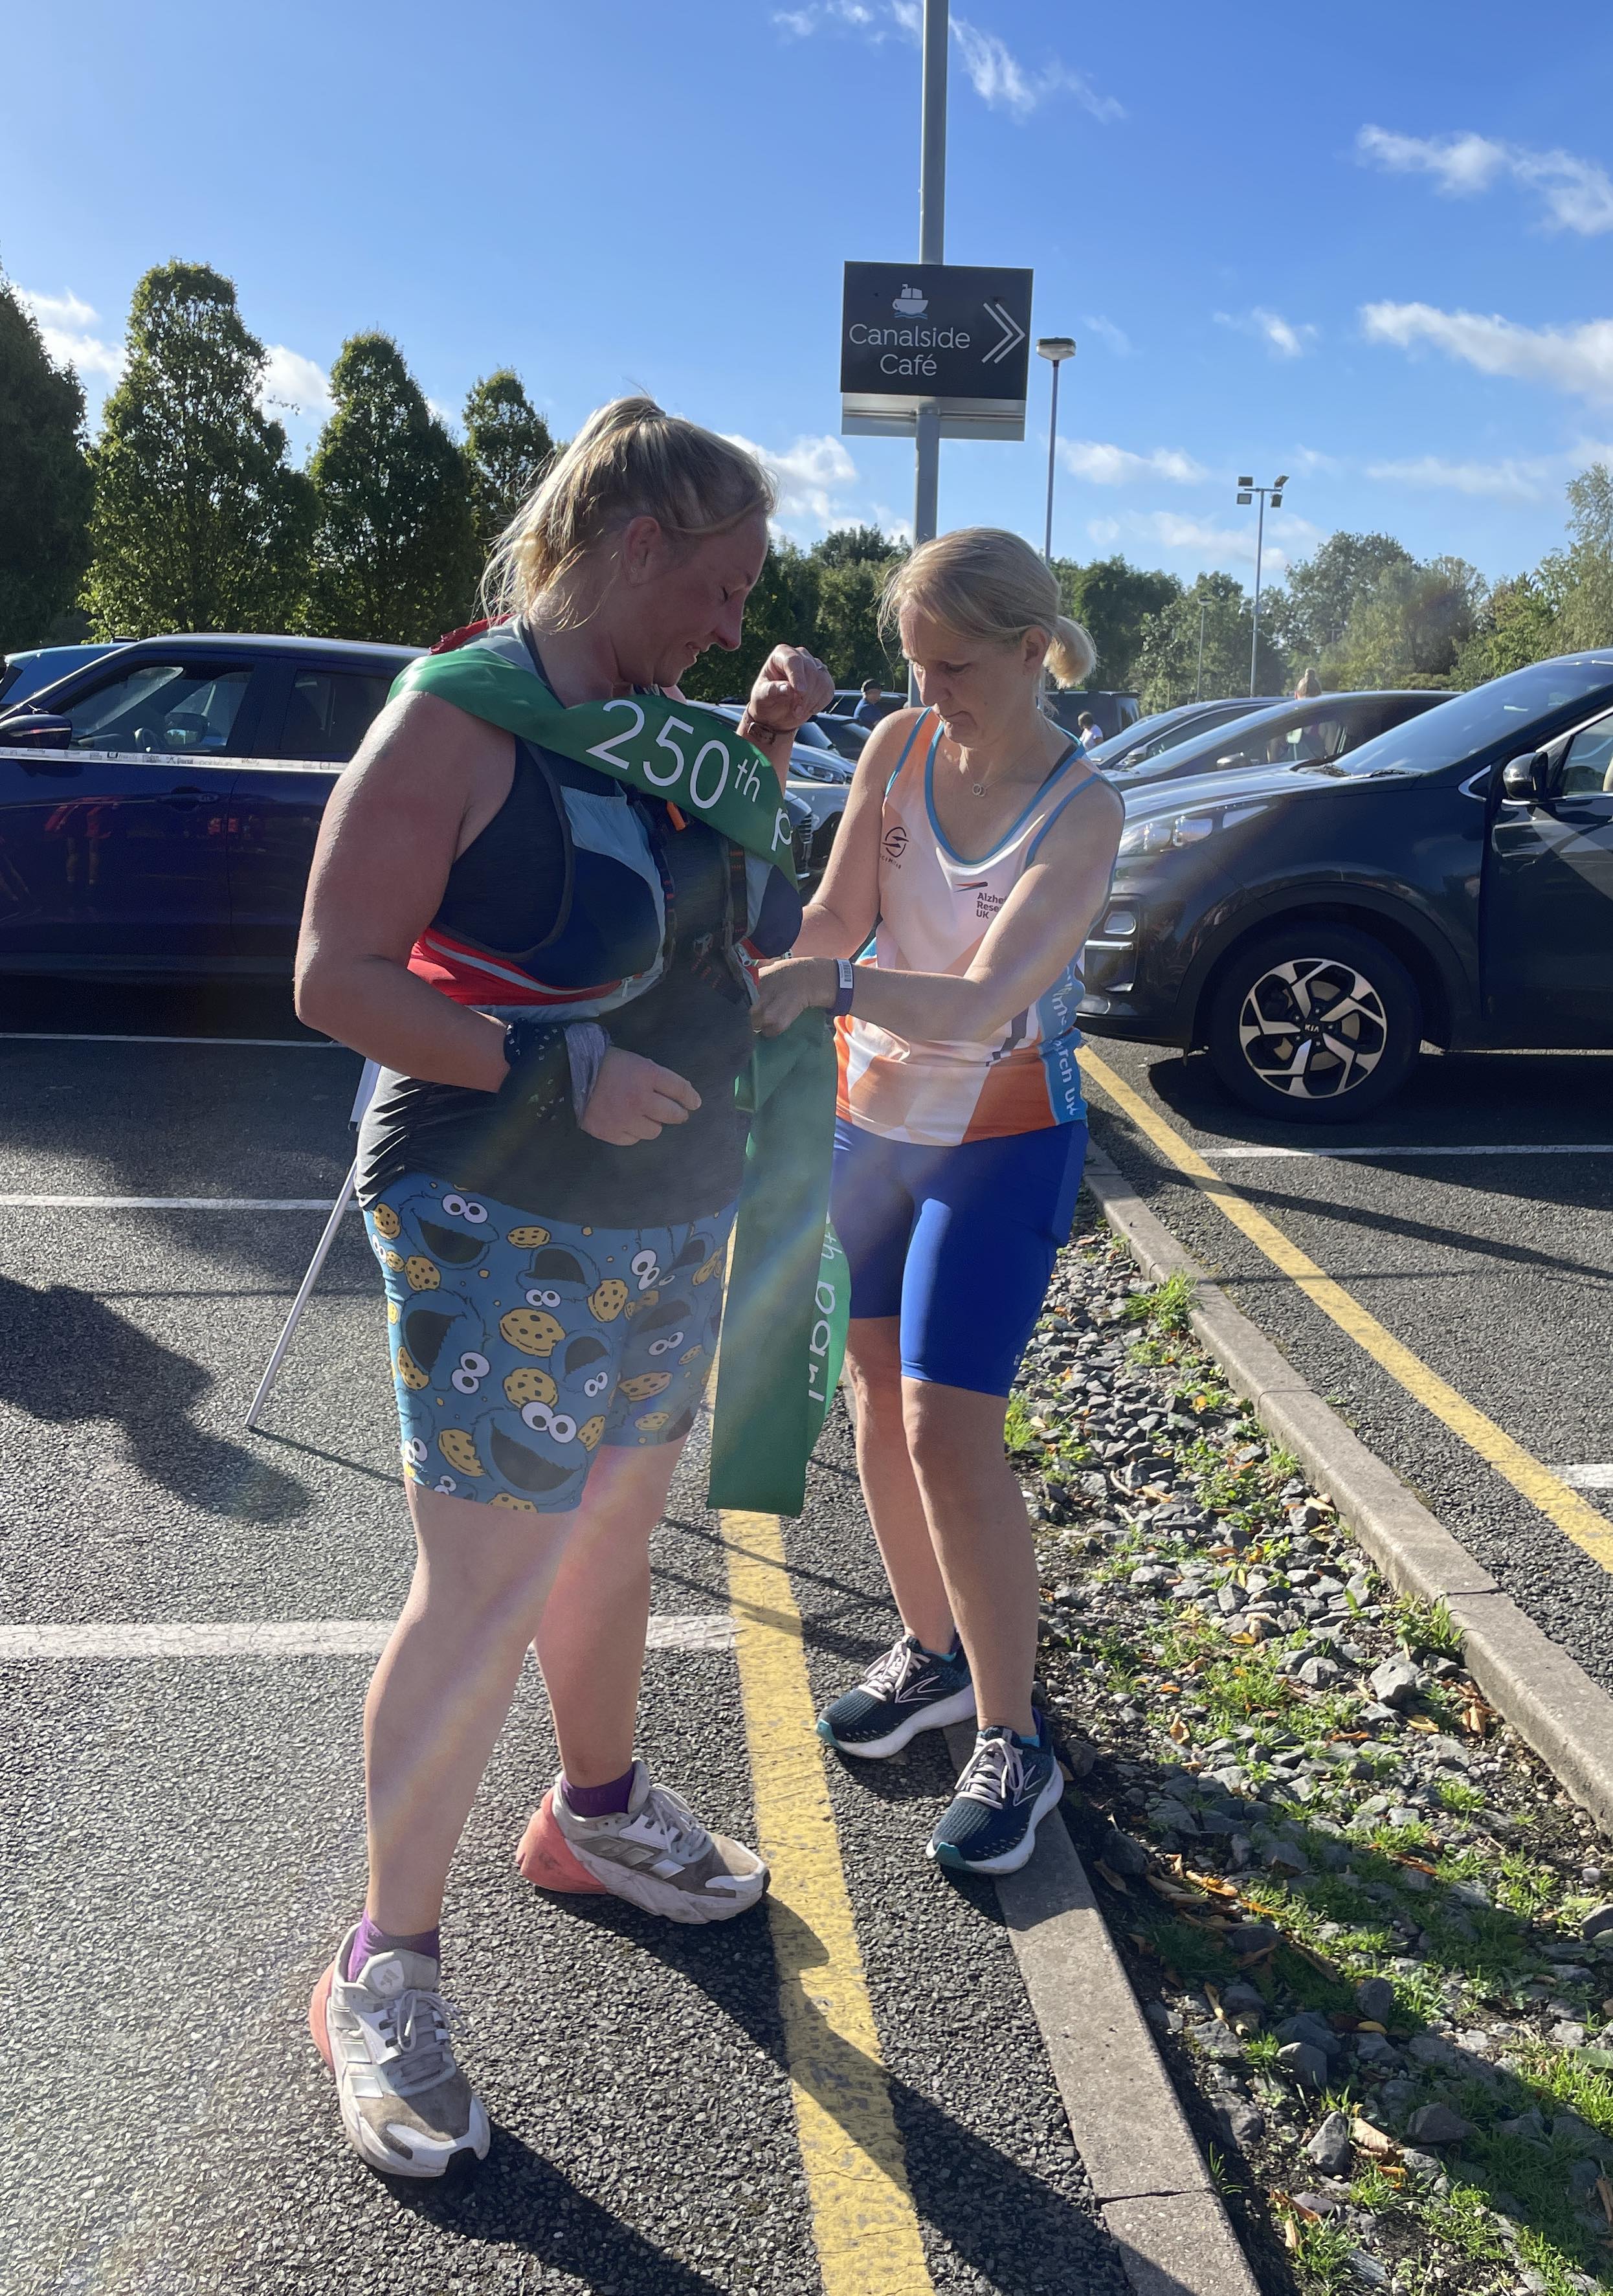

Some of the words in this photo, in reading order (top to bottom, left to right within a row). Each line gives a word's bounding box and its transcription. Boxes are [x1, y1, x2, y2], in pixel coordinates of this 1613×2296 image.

[849, 324, 971, 348] Canalside
[880, 353, 938, 376] Café
[585, 699, 761, 809] 250th
[771, 808, 792, 851] p
[976, 909, 989, 919] UK
[977, 900, 1002, 912] Rese
[1304, 1023, 1319, 1032] KIA
[1065, 1087, 1080, 1116] UK
